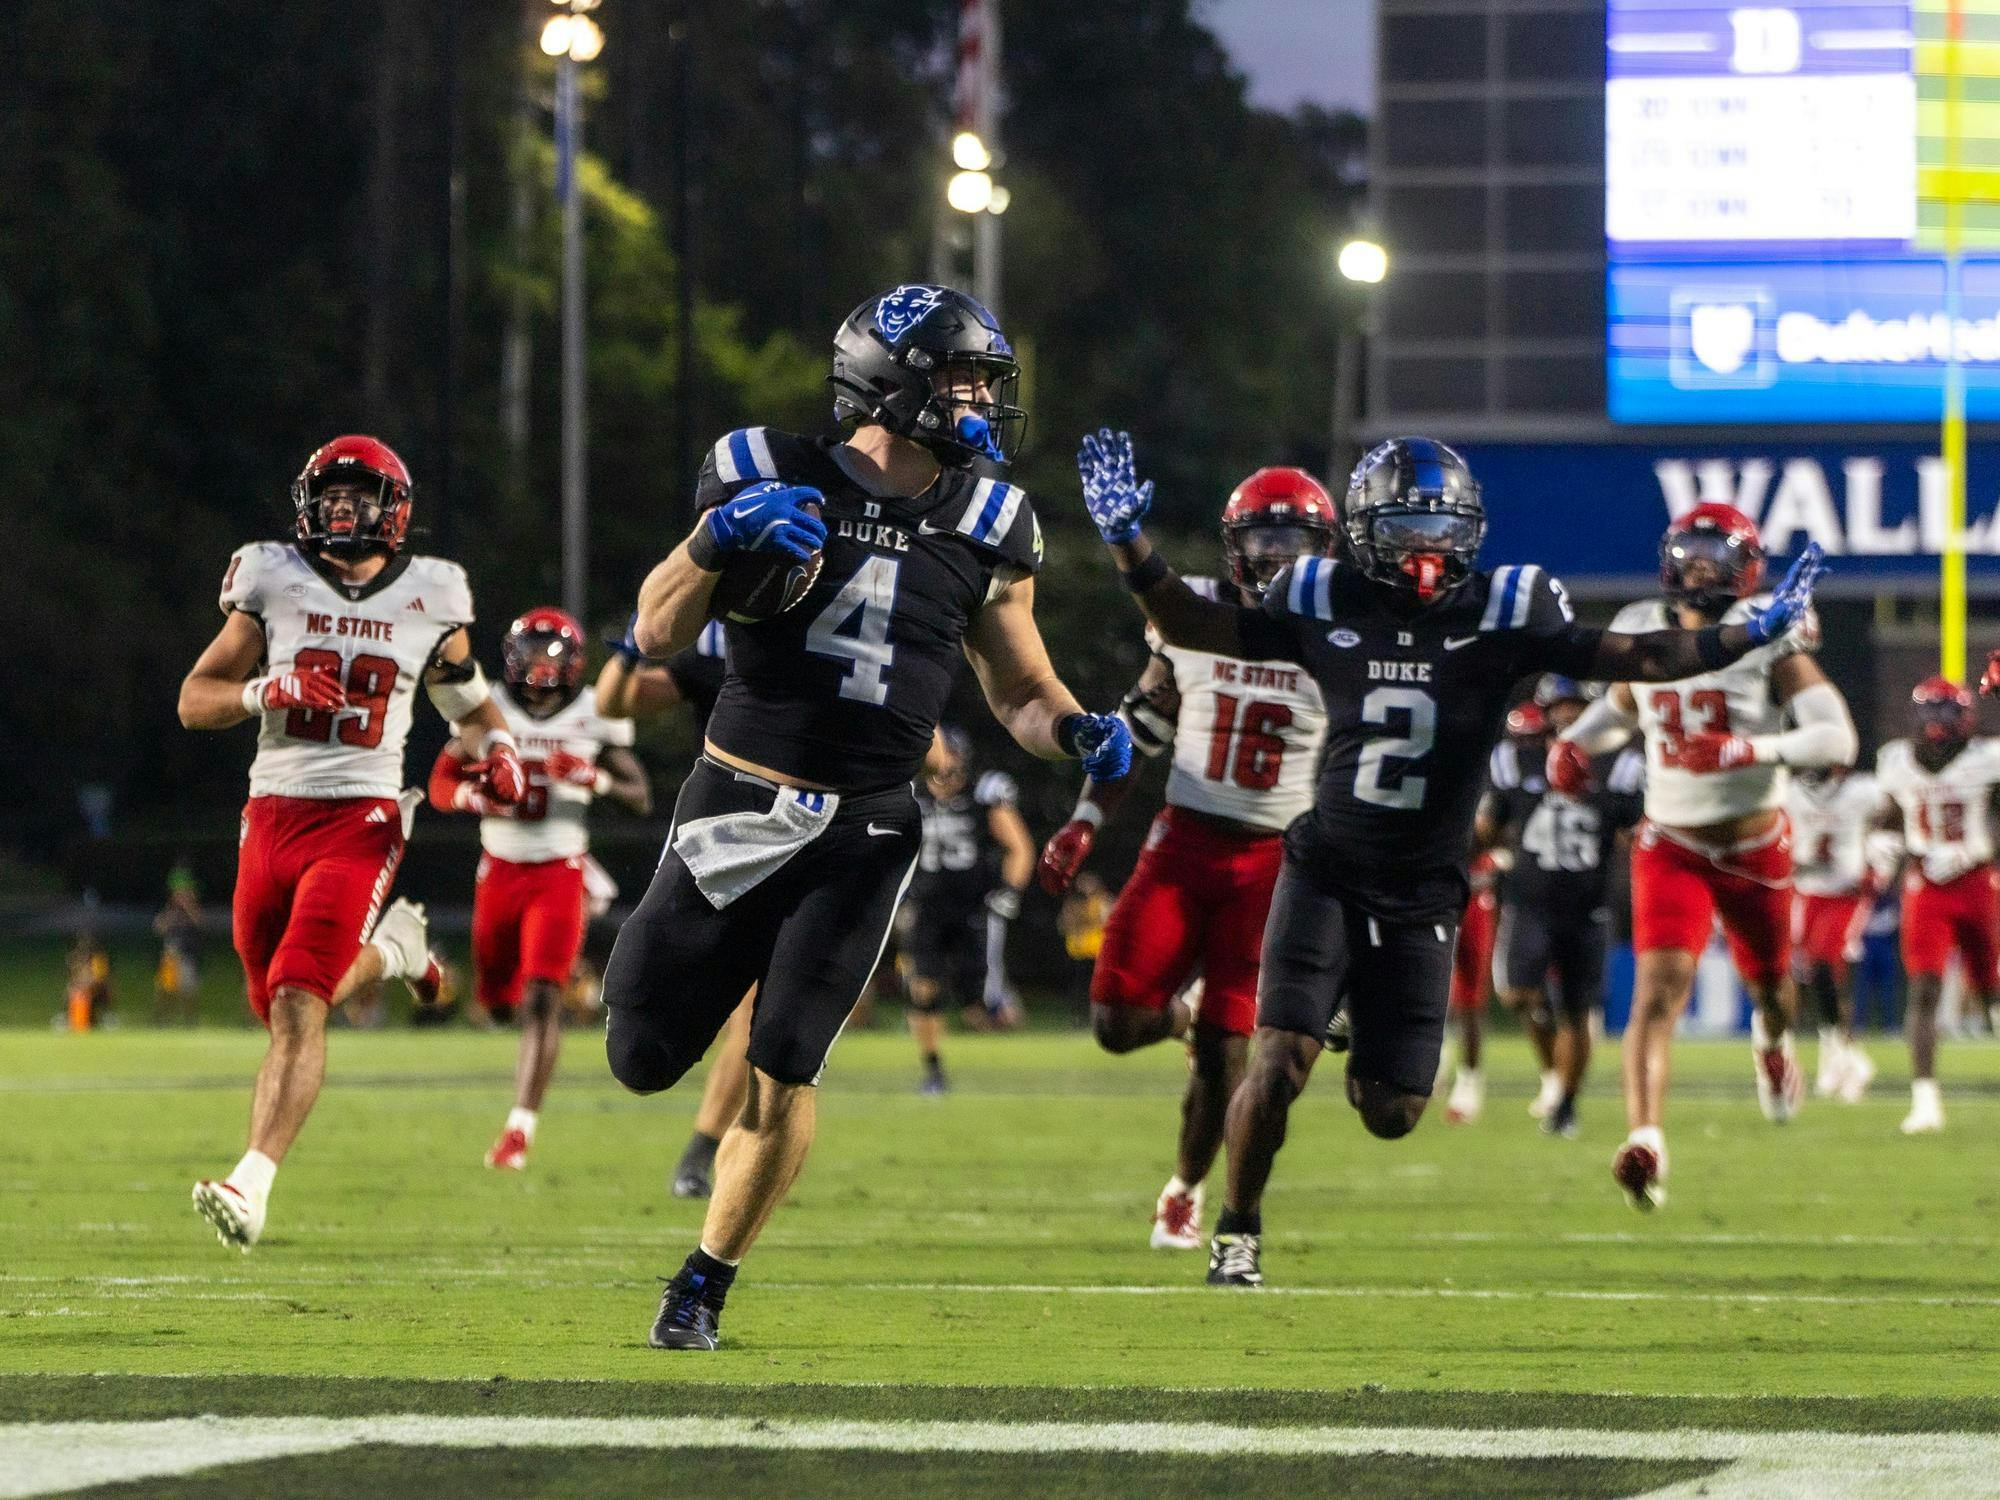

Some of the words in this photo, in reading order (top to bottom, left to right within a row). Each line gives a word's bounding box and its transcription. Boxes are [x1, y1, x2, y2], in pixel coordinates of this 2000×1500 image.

[838, 520, 909, 552] DUKE
[1653, 457, 2000, 556] WALL
[306, 613, 333, 634] NC
[336, 616, 394, 642] STATE
[805, 554, 900, 706] 4
[1213, 661, 1237, 683] NC
[1241, 666, 1298, 692] STATE
[1367, 660, 1433, 682] DUKE
[1205, 691, 1293, 791] 16
[1353, 686, 1437, 809] 2
